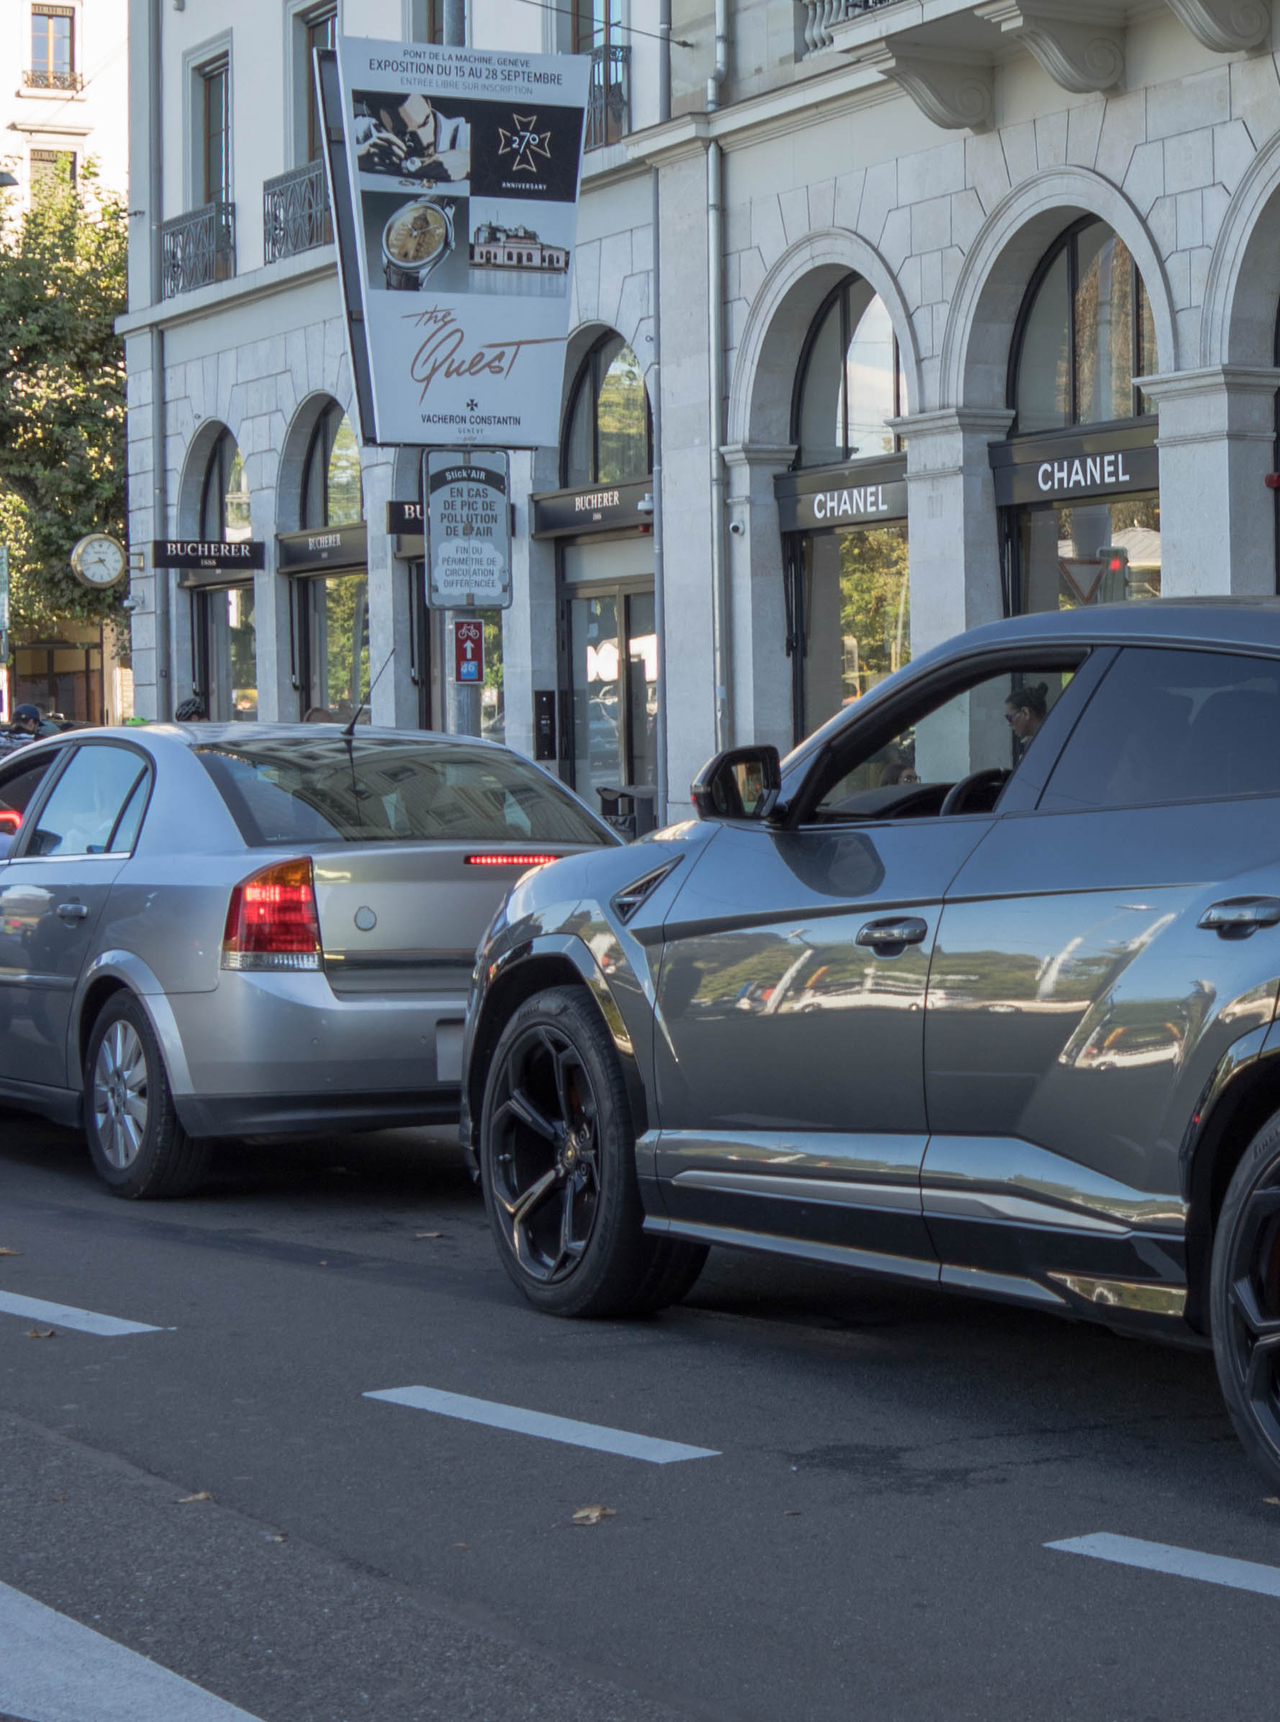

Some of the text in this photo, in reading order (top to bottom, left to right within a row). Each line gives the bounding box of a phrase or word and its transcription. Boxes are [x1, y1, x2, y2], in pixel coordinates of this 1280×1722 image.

[403, 49, 426, 60] PONT
[429, 52, 441, 61] DE
[441, 53, 454, 62] LA
[369, 58, 563, 86] EXPOSITION DU 15 AU 28 SEPTEMBRE
[435, 77, 460, 90] LIBRE
[462, 80, 480, 92] SUR
[480, 81, 533, 96] INSCRIPTION
[512, 131, 539, 154] 270
[502, 181, 547, 191] ANNIVERSARY
[421, 414, 521, 426] VACHERON CONSTANTIN
[445, 468, 486, 481] Stick'AIR
[1037, 453, 1130, 491] CHANEL
[449, 487, 489, 499] EN CAS
[443, 500, 496, 512] DE PIC DE
[575, 491, 620, 512] BUCHERER
[813, 485, 888, 519] CHANEL
[440, 512, 498, 524] POLLUTION
[445, 525, 459, 536] DE
[308, 533, 342, 550] BUCHERER
[166, 543, 251, 558] BUCHERER
[455, 545, 483, 555] FIN DU
[486, 557, 498, 566] DE
[445, 568, 495, 578] CIRCULATION
